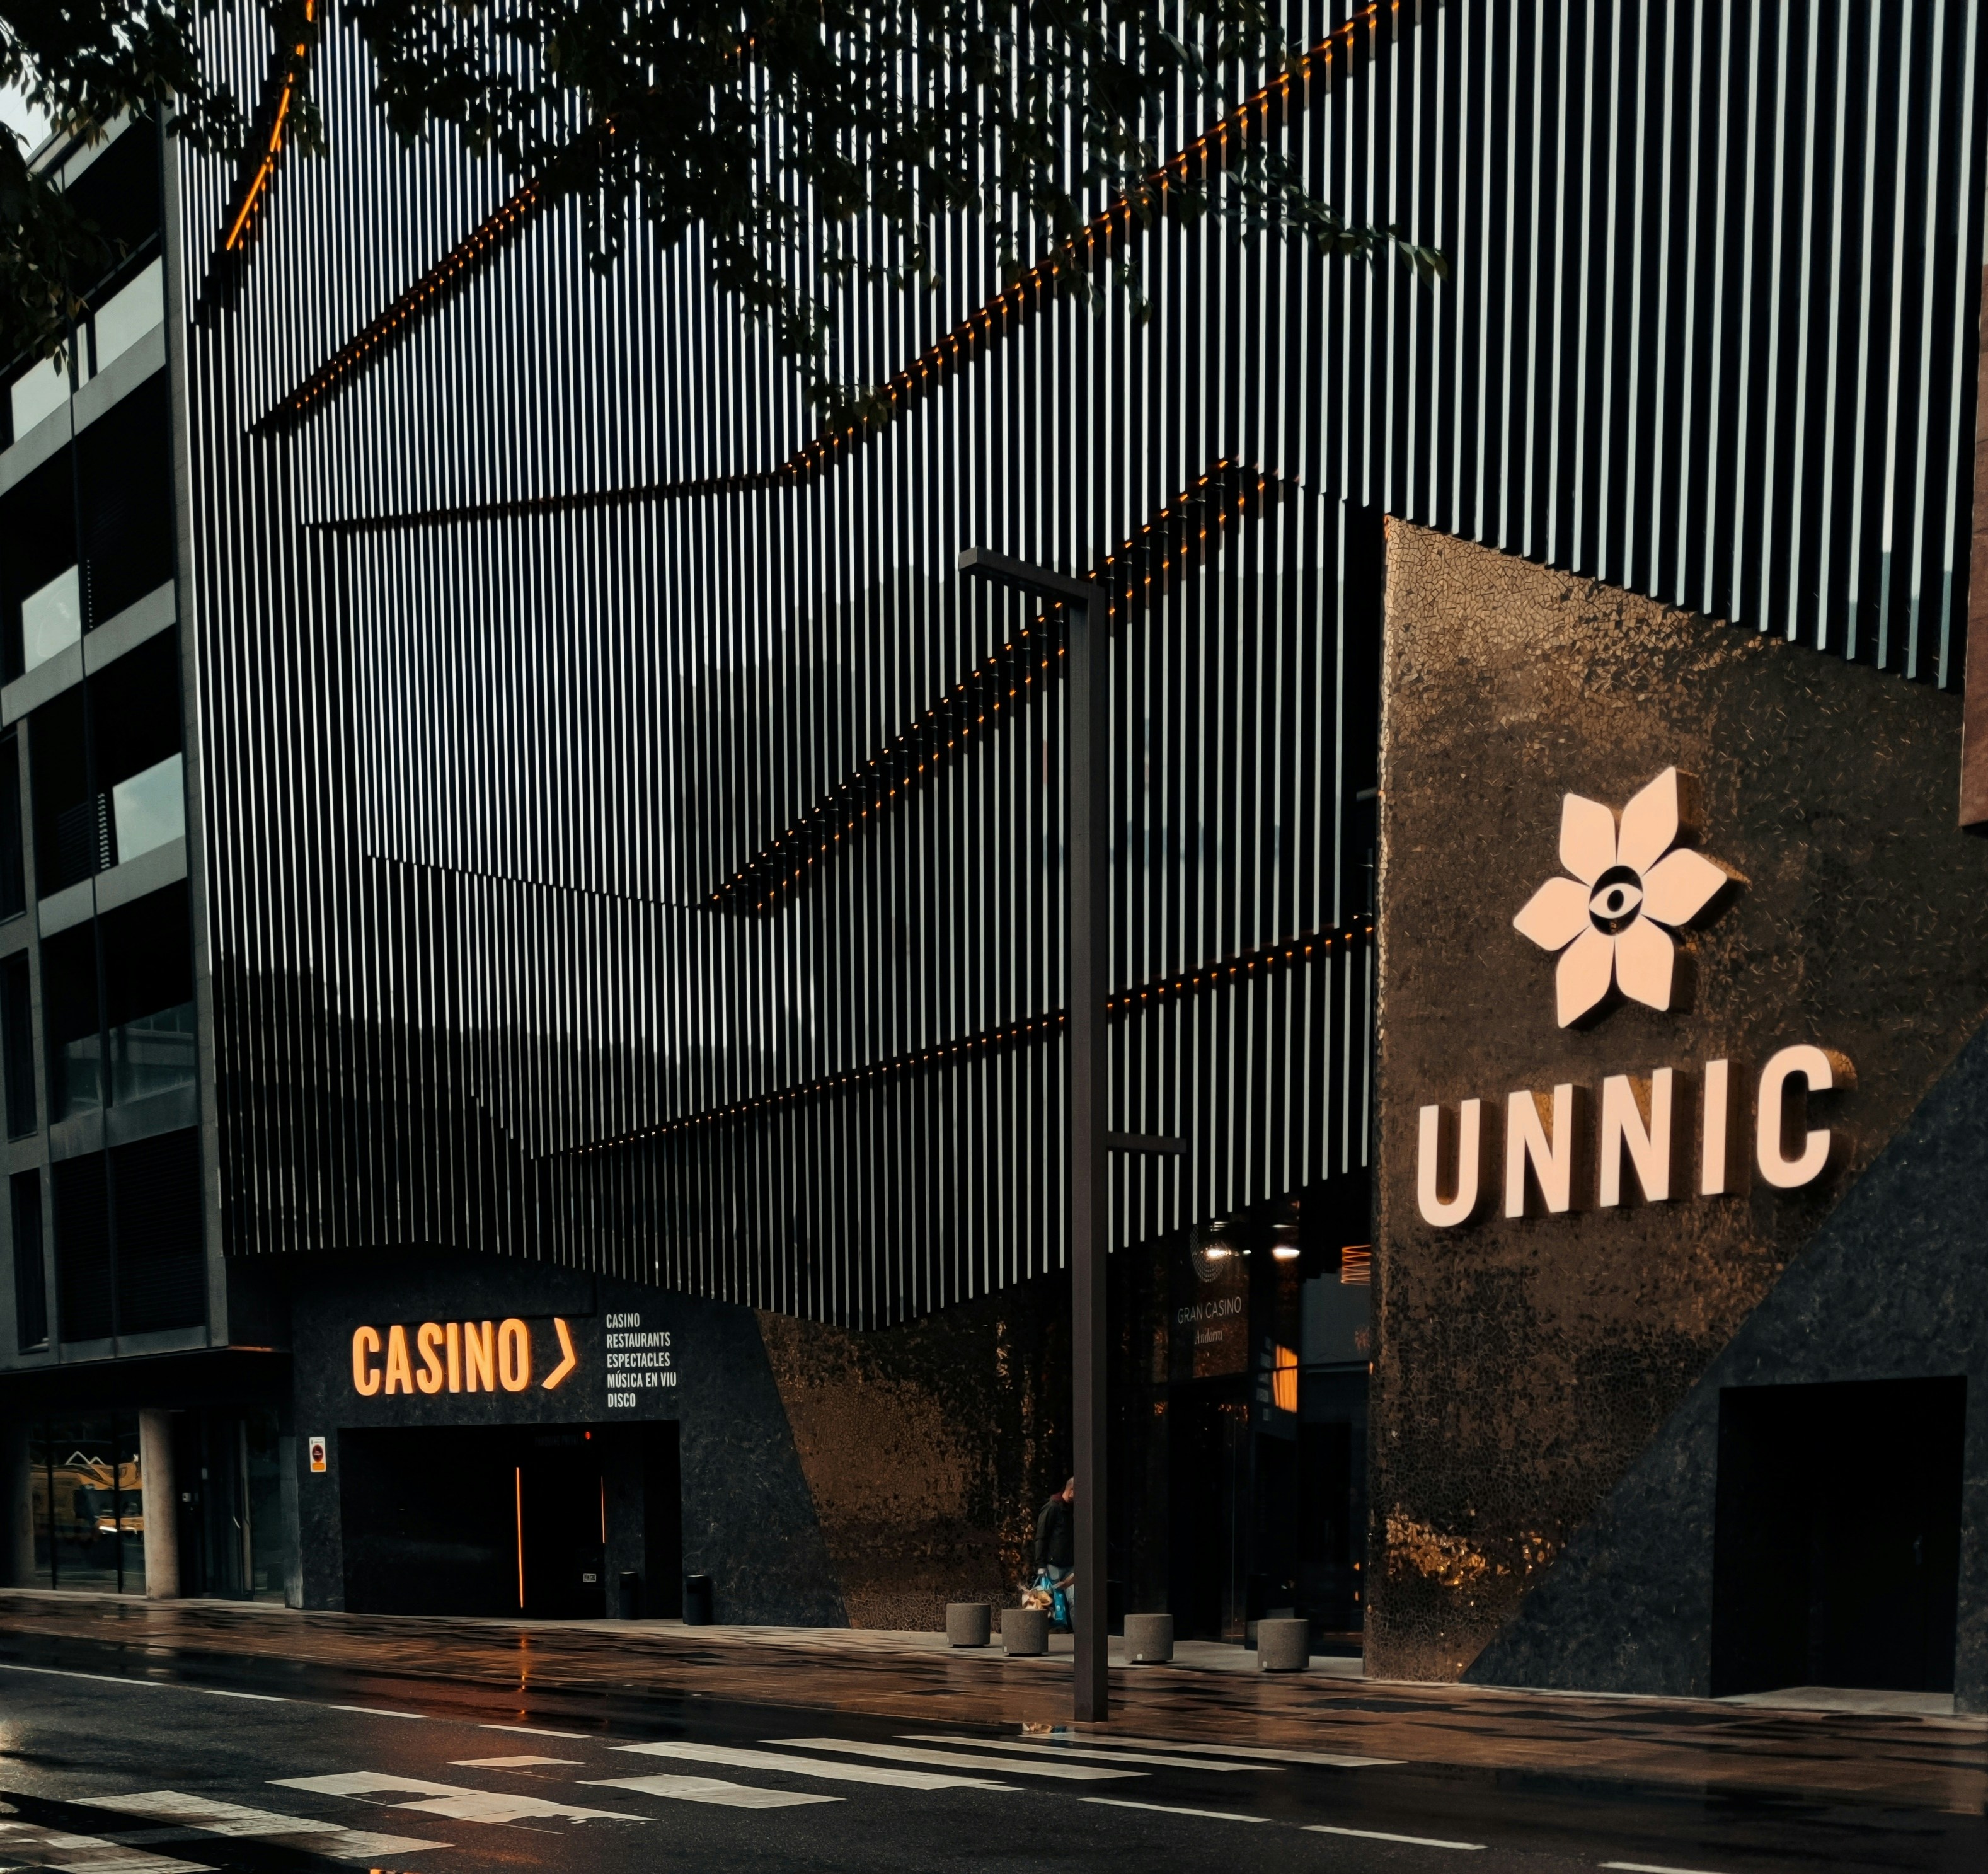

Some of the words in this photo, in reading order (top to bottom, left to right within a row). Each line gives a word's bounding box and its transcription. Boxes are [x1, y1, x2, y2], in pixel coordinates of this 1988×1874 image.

[1416, 1043, 1834, 1227] UNNIC
[1178, 1304, 1203, 1325] GRAN
[1205, 1296, 1242, 1319] CASINO
[606, 1313, 640, 1328] CASINO
[606, 1331, 671, 1348] RESTAURANTS
[352, 1318, 529, 1396] CASINO
[607, 1352, 670, 1368] ESPECTACLES
[607, 1370, 643, 1388] MÚSICA
[645, 1372, 658, 1388] EN
[660, 1371, 677, 1388] VIU
[607, 1393, 636, 1408] DISCO
